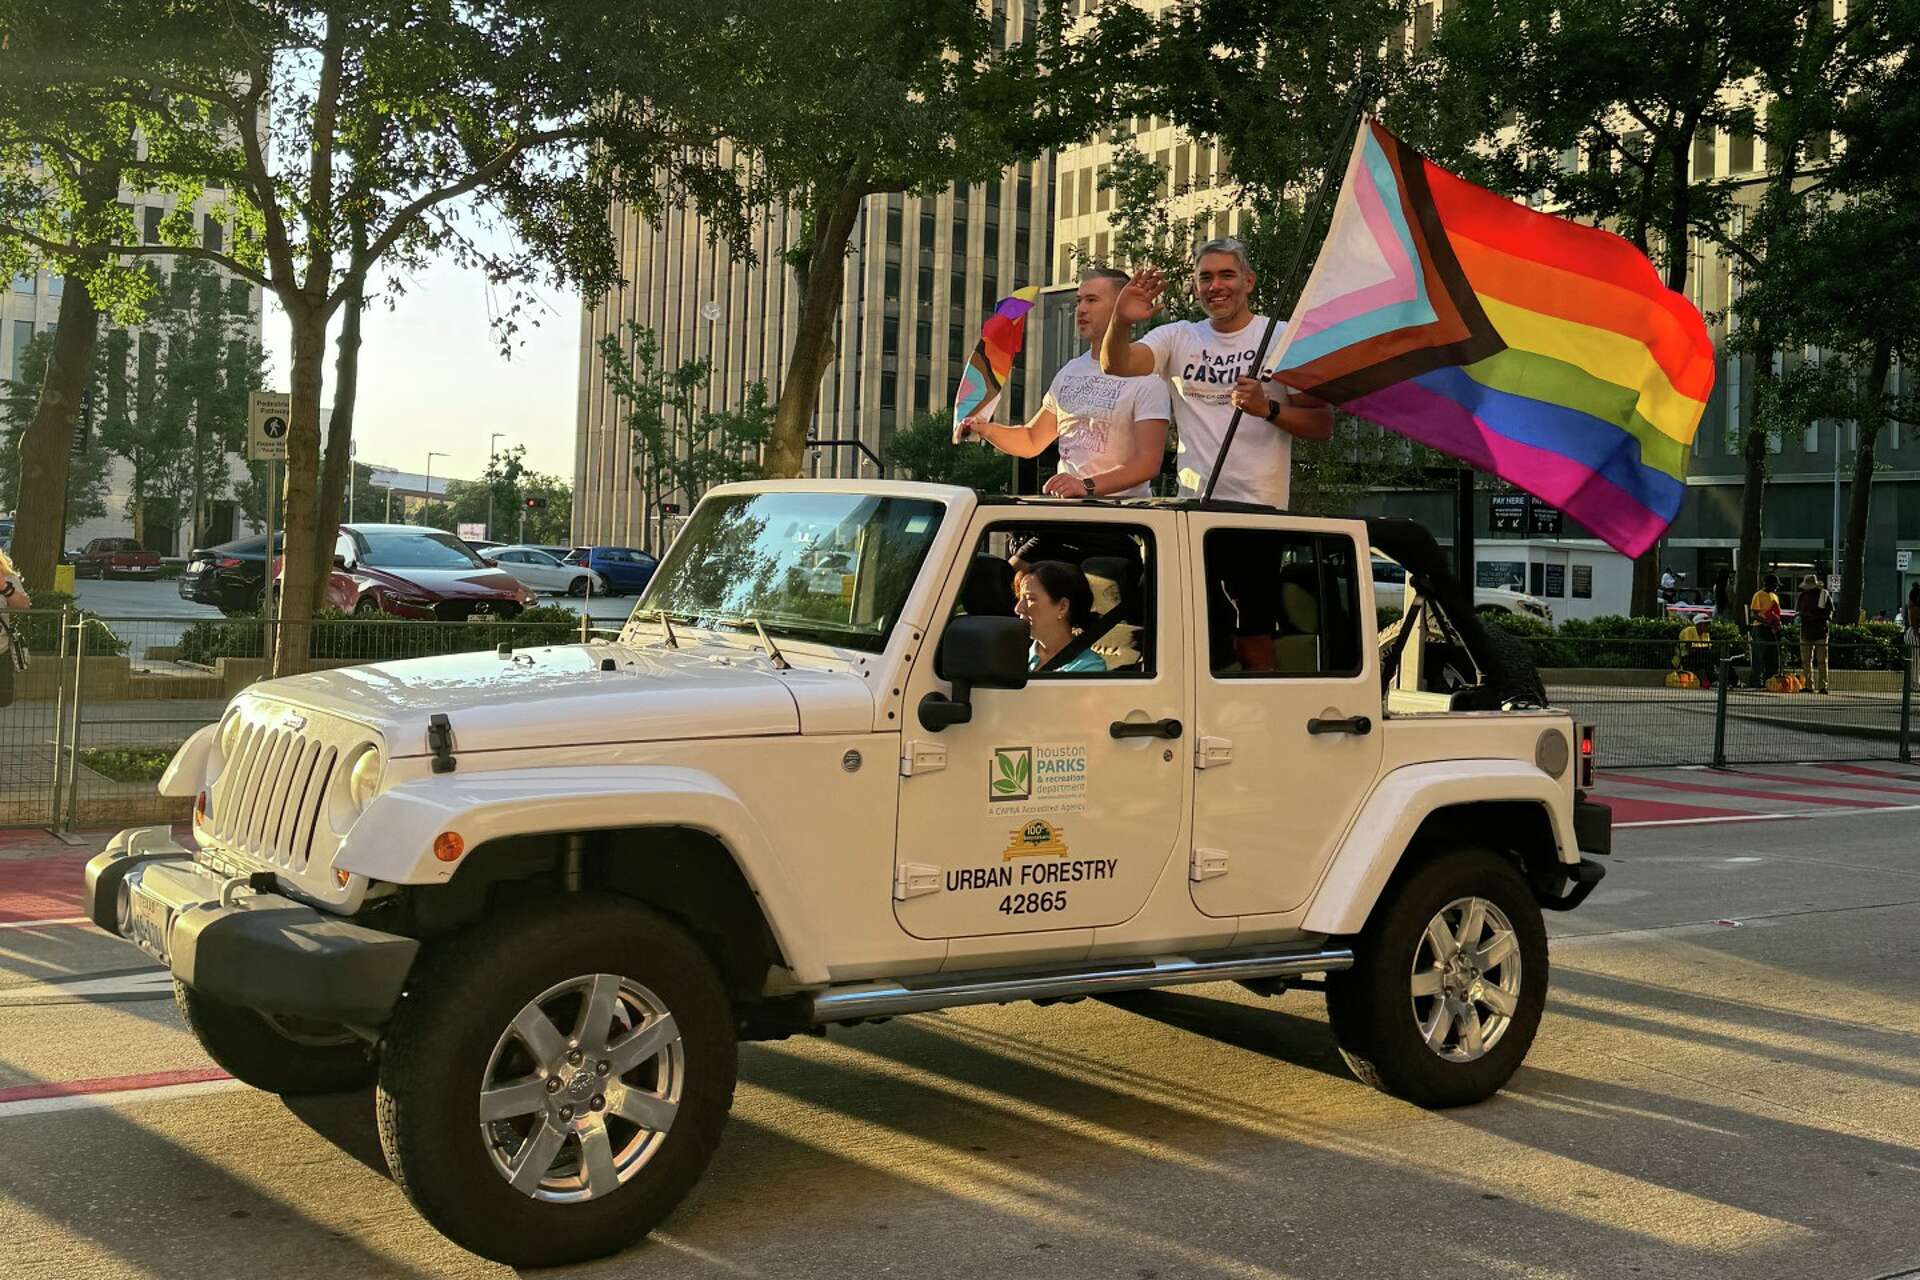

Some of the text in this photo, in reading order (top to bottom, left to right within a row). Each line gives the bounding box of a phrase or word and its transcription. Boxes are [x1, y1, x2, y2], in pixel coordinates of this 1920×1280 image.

[1493, 497, 1525, 505] PAY HERE
[1037, 746, 1085, 758] houston
[1037, 758, 1085, 774] PARKS
[1046, 774, 1085, 783] recreation
[1037, 783, 1085, 794] department
[946, 859, 1118, 891] URBAN FORESTRY
[998, 891, 1067, 915] 42865
